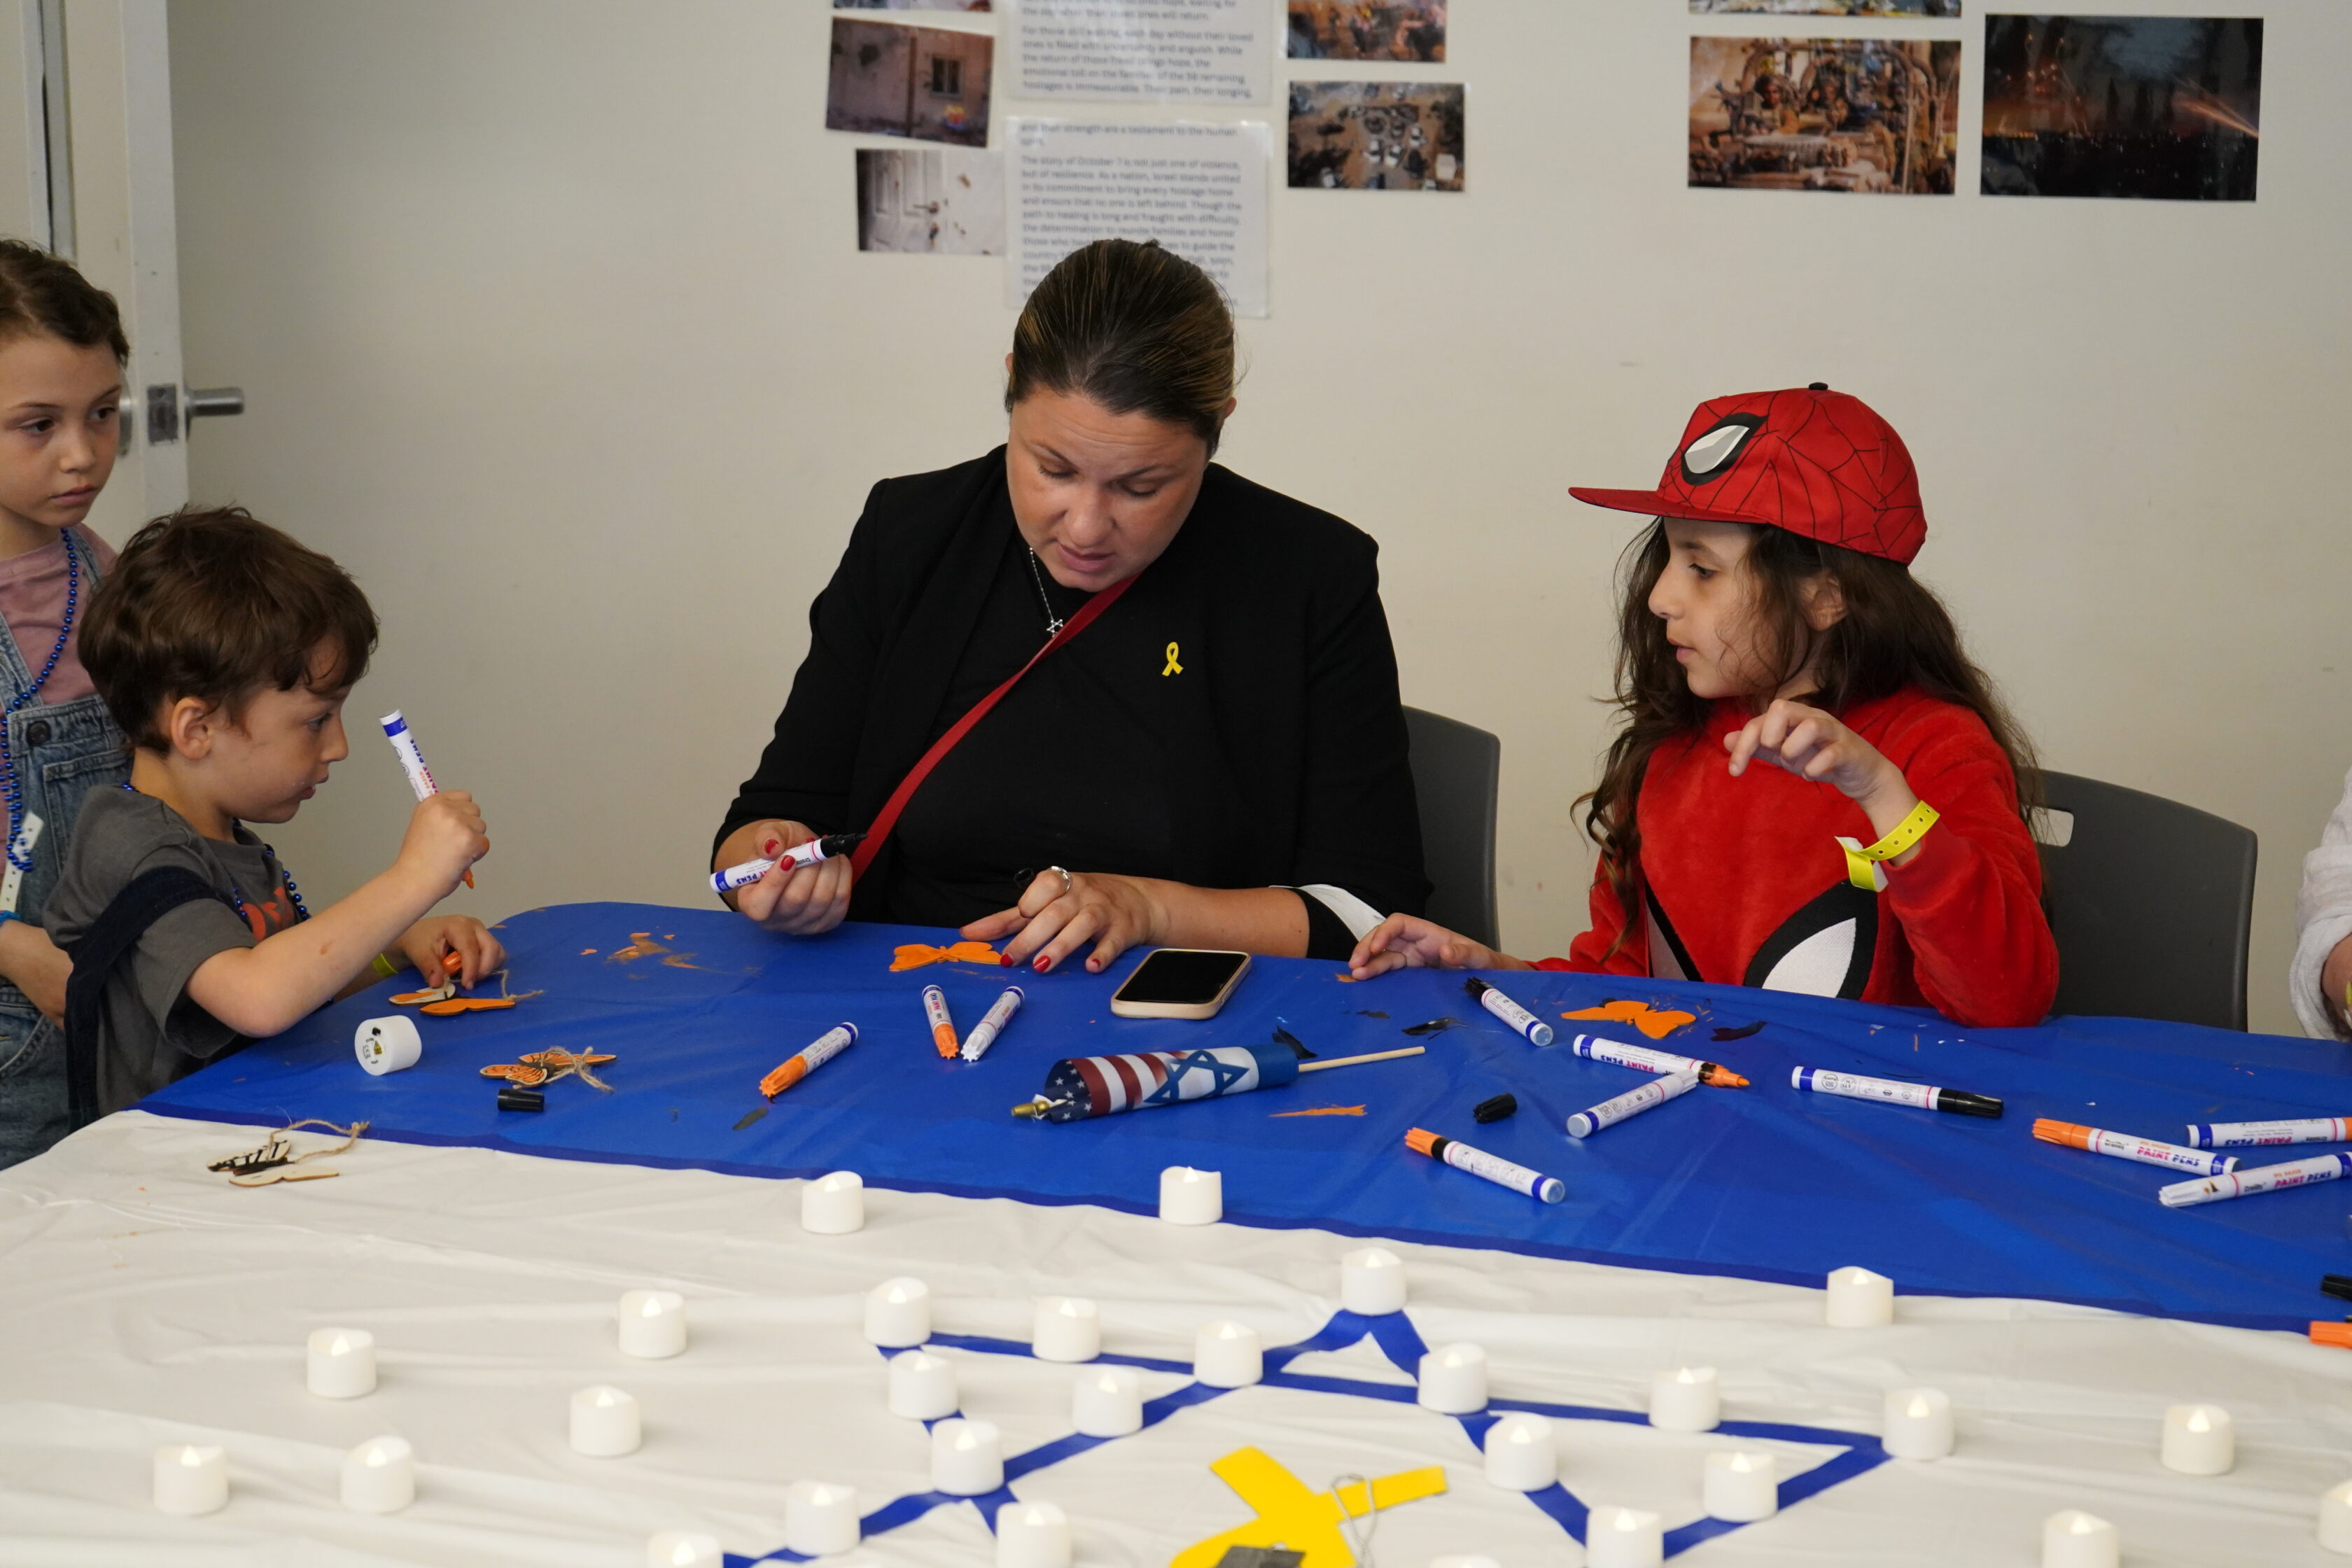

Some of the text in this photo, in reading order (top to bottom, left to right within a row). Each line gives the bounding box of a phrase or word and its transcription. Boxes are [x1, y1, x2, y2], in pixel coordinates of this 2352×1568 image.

[736, 874, 758, 885] PENS
[1601, 1055, 1623, 1065] PENS
[1626, 1060, 1654, 1072] PAINT
[2256, 1136, 2293, 1144] PAINT
[2137, 1147, 2171, 1160] PAINT
[2275, 1175, 2306, 1188] PAINT
[2307, 1171, 2332, 1182] PENS
